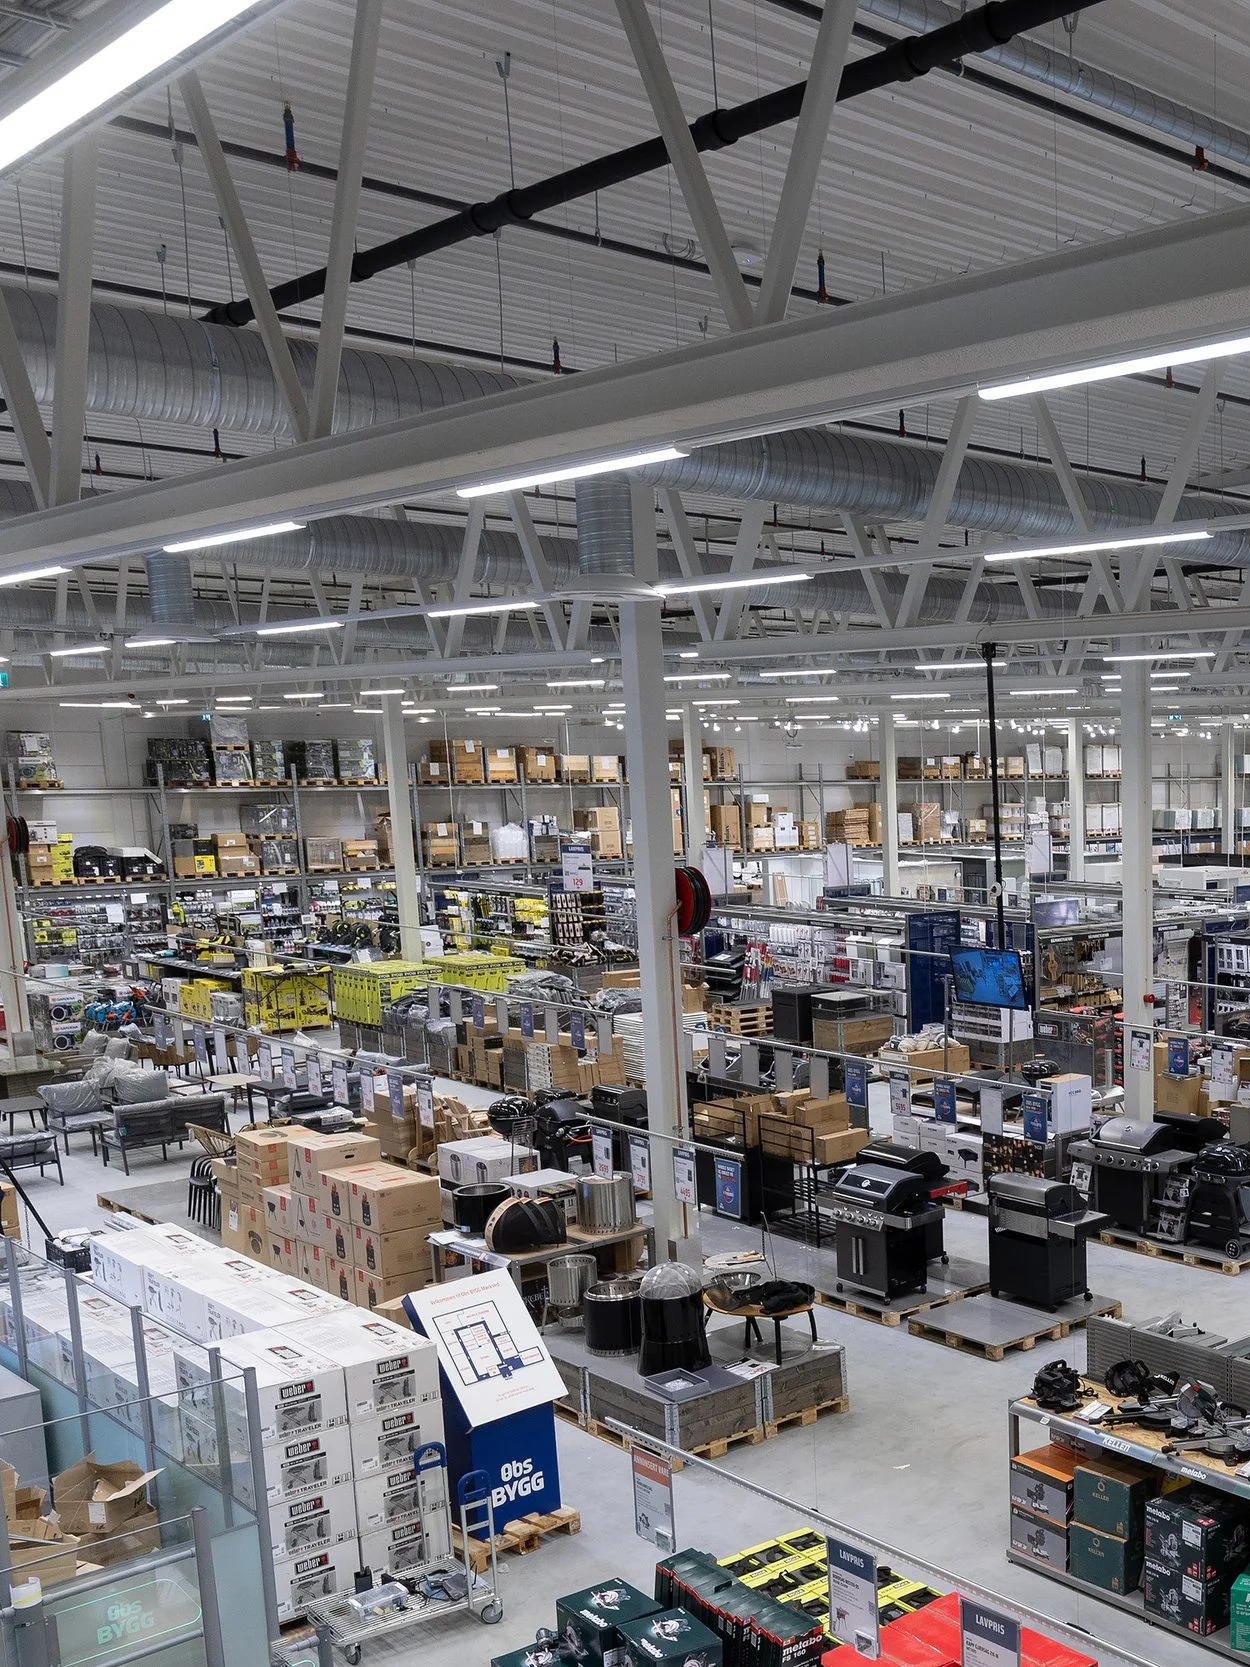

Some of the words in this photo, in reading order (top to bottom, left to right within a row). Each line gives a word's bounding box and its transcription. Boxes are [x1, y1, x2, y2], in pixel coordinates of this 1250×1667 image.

[379, 1358, 401, 1374] weber
[282, 1382, 306, 1398] weber
[294, 1422, 322, 1436] TRAVELER
[384, 1414, 406, 1430] weber
[288, 1441, 312, 1458] weber
[1102, 1436, 1130, 1452] KELLEN
[500, 1458, 532, 1482] Obs
[634, 1454, 657, 1476] ANNONSERT
[1180, 1466, 1208, 1480] metabo
[300, 1480, 327, 1493] TRAVELER
[389, 1470, 412, 1487] weber
[491, 1470, 544, 1508] BYGG
[291, 1499, 315, 1516] weber
[1146, 1505, 1171, 1522] metabo
[394, 1524, 416, 1540] weber
[304, 1538, 330, 1550] TRAVELER
[296, 1556, 320, 1573] weber
[840, 1549, 864, 1568] LAVPRIS
[1146, 1560, 1171, 1576] metabo
[107, 1599, 142, 1620] Obs
[580, 1609, 608, 1627] metabo
[97, 1612, 154, 1645] BYGG
[976, 1614, 1005, 1636] LAVPRIS
[640, 1638, 663, 1658] metabo
[782, 1634, 822, 1656] metabo
[782, 1653, 792, 1663] FS
[793, 1648, 806, 1660] 160
